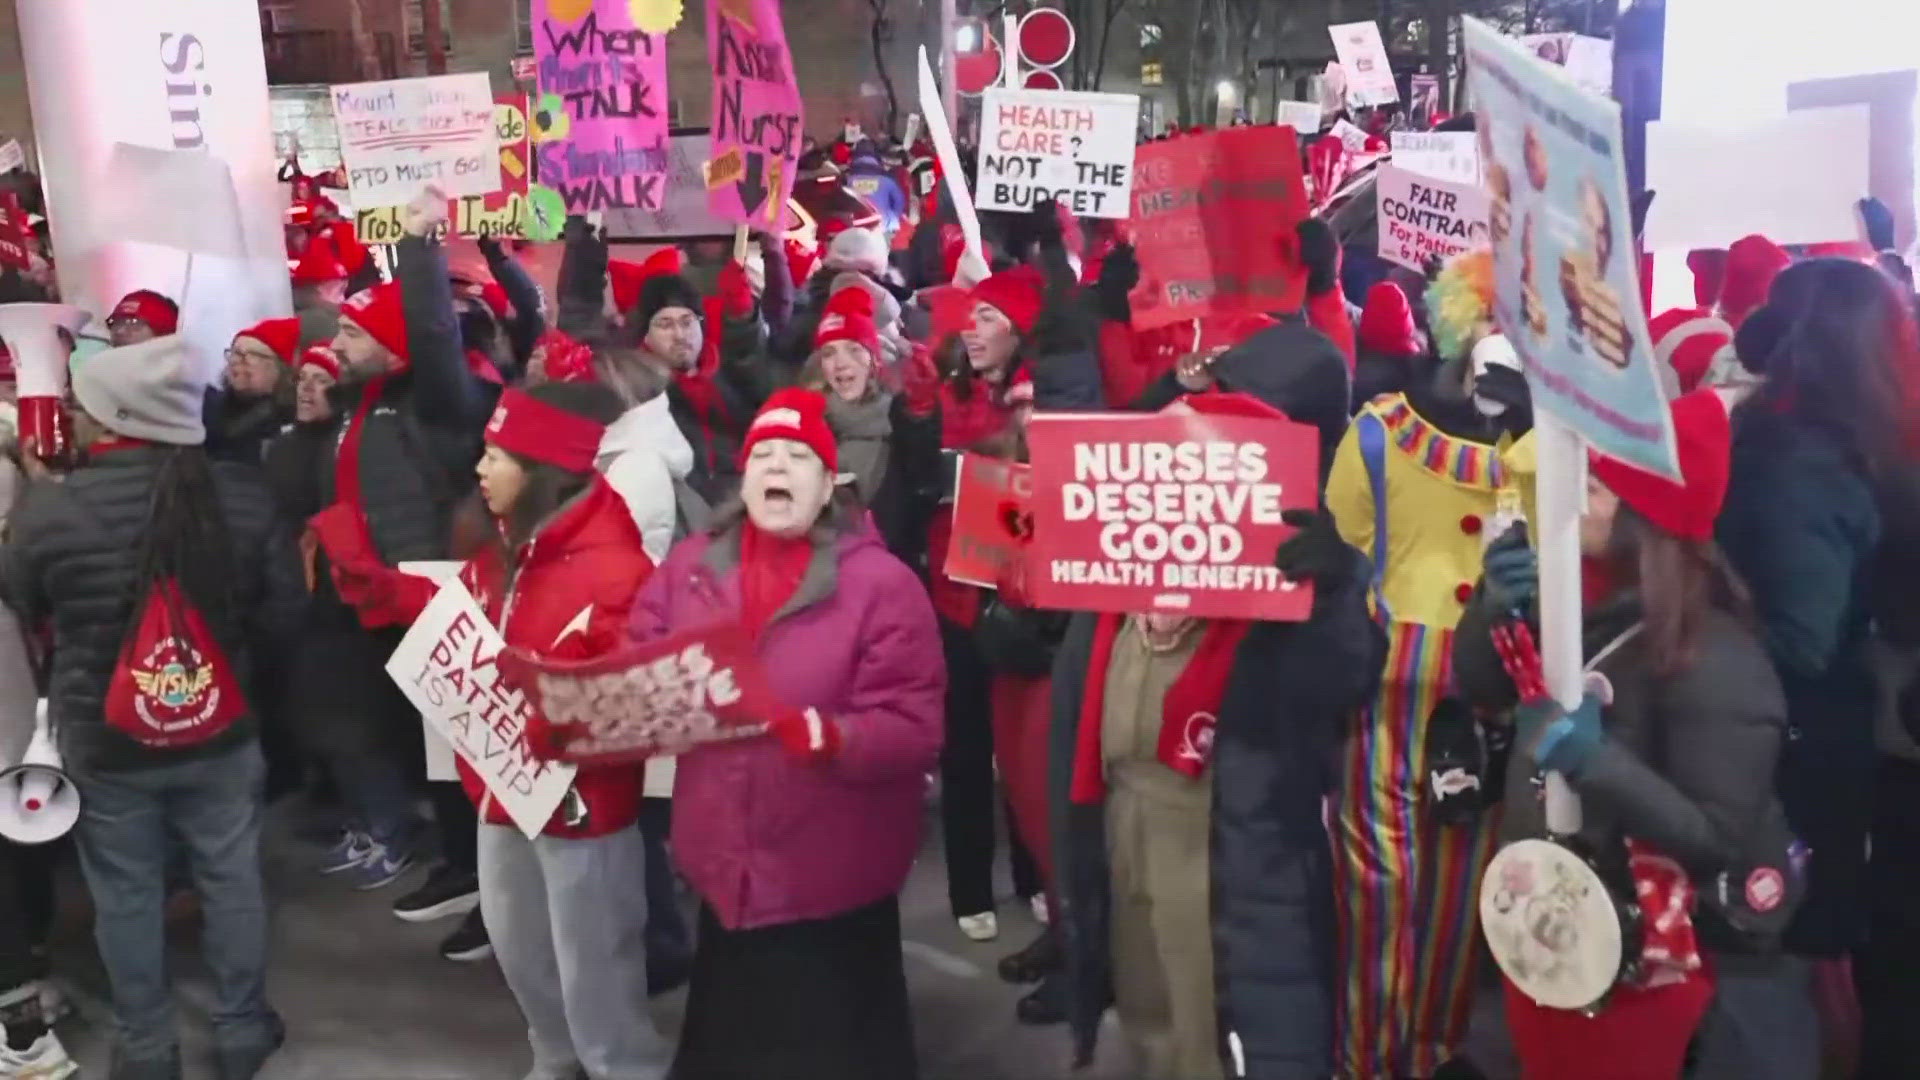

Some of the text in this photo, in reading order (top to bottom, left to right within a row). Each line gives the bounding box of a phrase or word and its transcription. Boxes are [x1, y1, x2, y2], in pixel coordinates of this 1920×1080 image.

[543, 11, 652, 56] When
[160, 32, 212, 149] Sin
[564, 81, 657, 119] TALK
[999, 105, 1093, 131] HEALTH
[350, 167, 388, 190] PTO
[396, 160, 444, 182] MUST
[985, 154, 1126, 186] NOT THE
[558, 175, 658, 211] WALK
[1409, 183, 1457, 212] FAIR
[460, 195, 525, 238] Inside
[1389, 222, 1411, 242] For
[1074, 441, 1268, 483] NURSES
[1062, 482, 1283, 524] DESERVE
[1100, 522, 1243, 563] GOOD
[1051, 559, 1154, 587] HEALTH
[414, 664, 448, 707] IS
[449, 711, 471, 737] A
[484, 732, 533, 796] VIP
